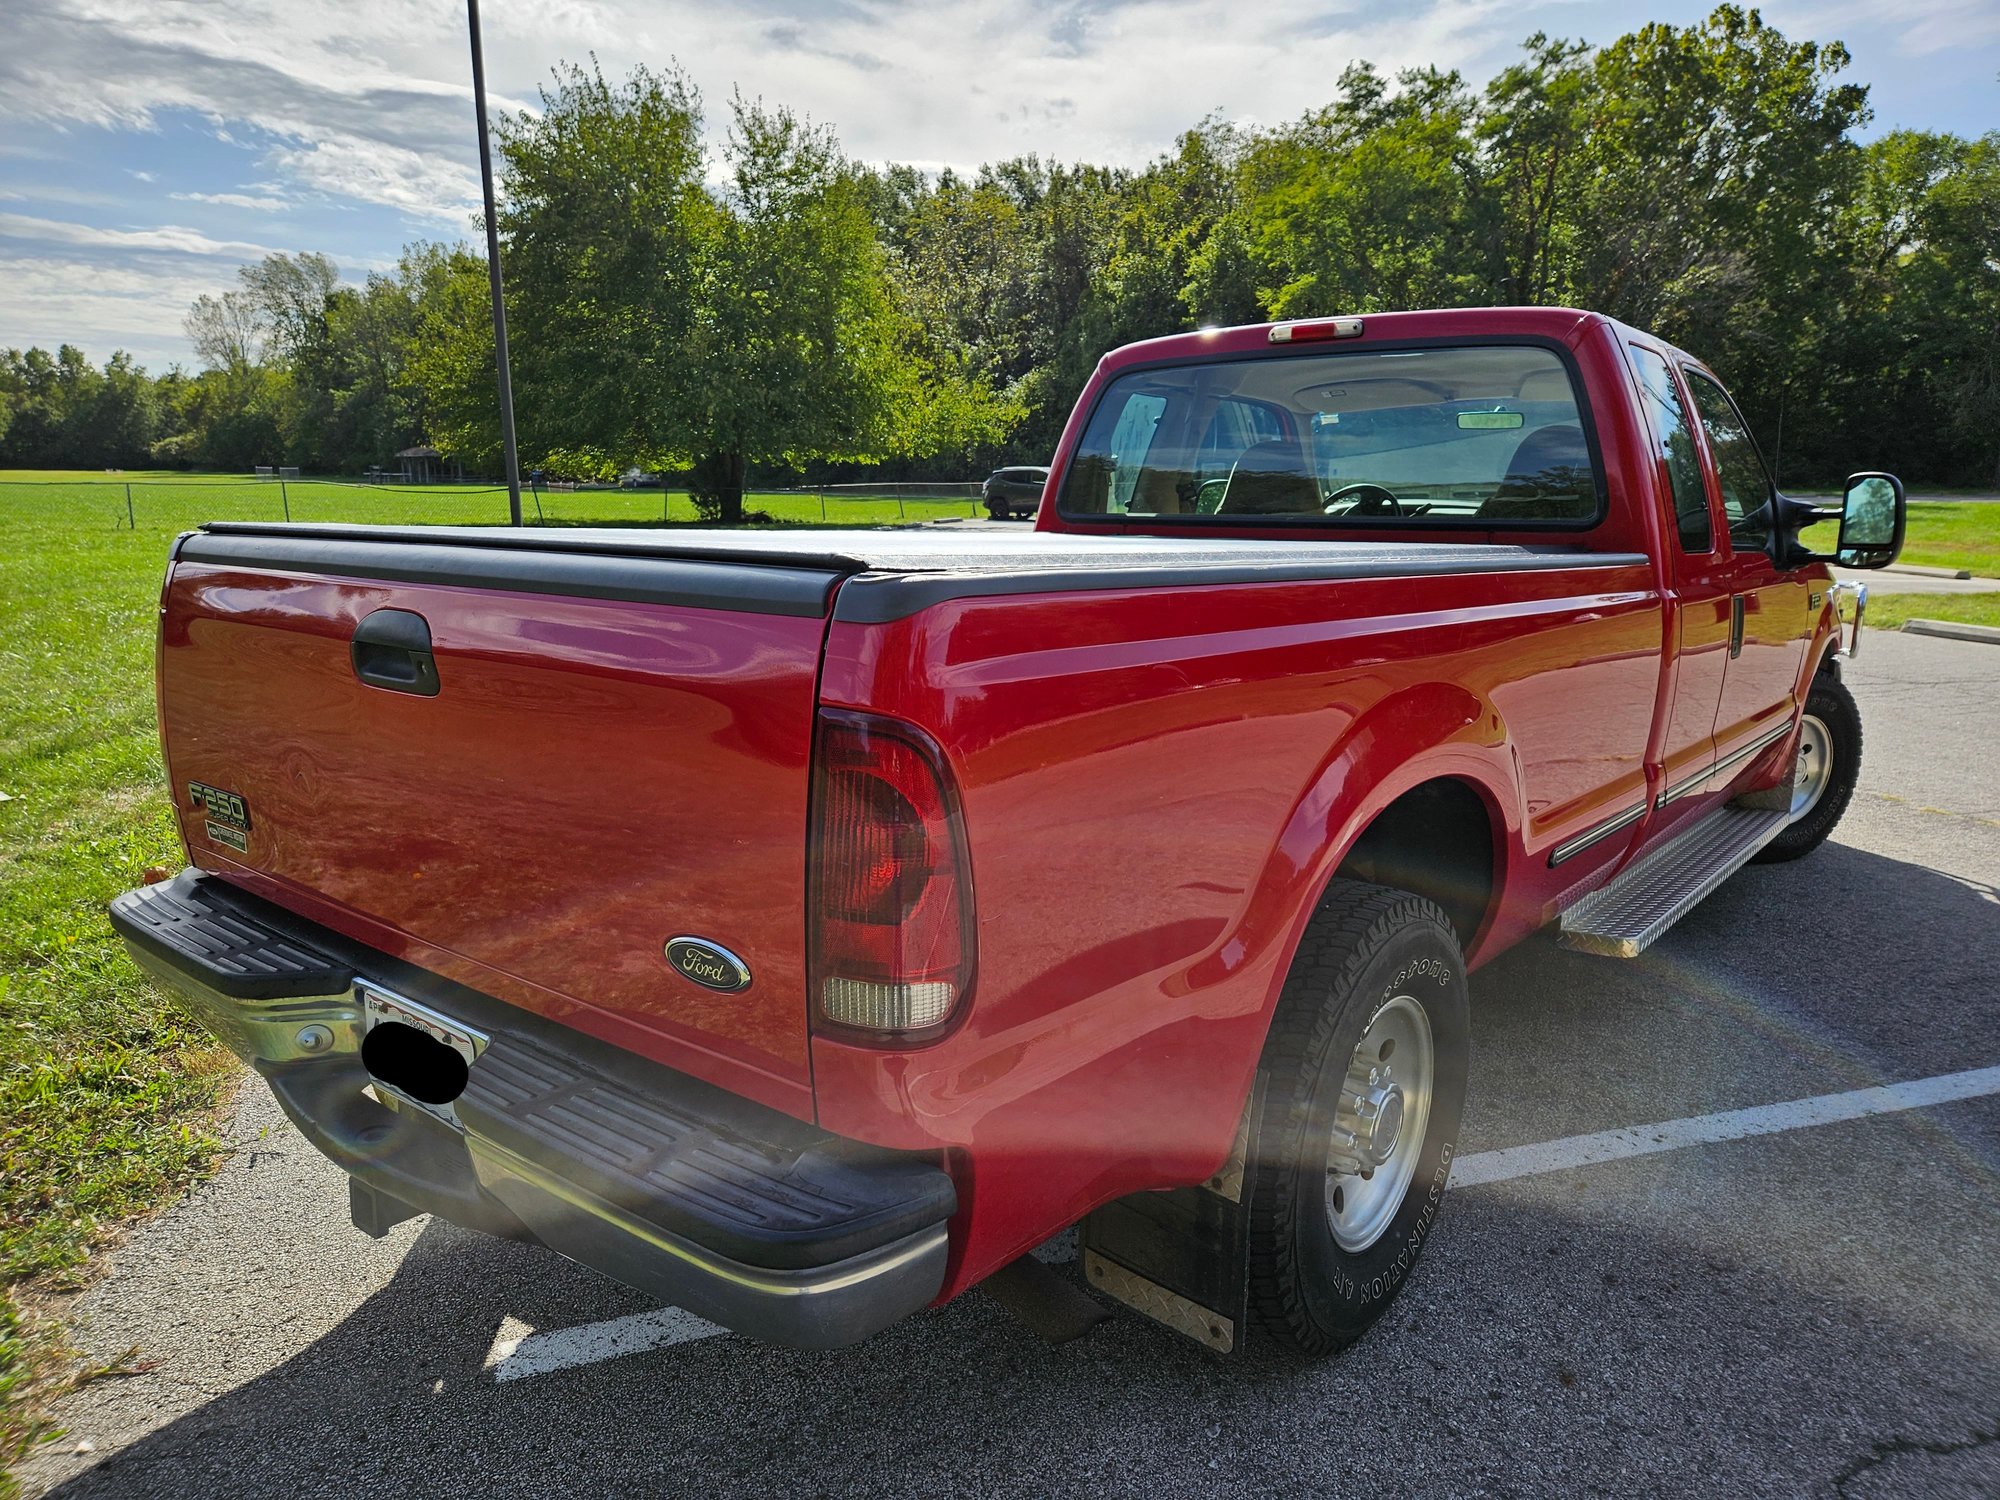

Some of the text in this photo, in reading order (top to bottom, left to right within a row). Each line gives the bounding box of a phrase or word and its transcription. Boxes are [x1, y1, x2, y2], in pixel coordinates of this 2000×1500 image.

[683, 947, 725, 981] Ford
[1332, 1143, 1453, 1304] DESTINATION A/T
